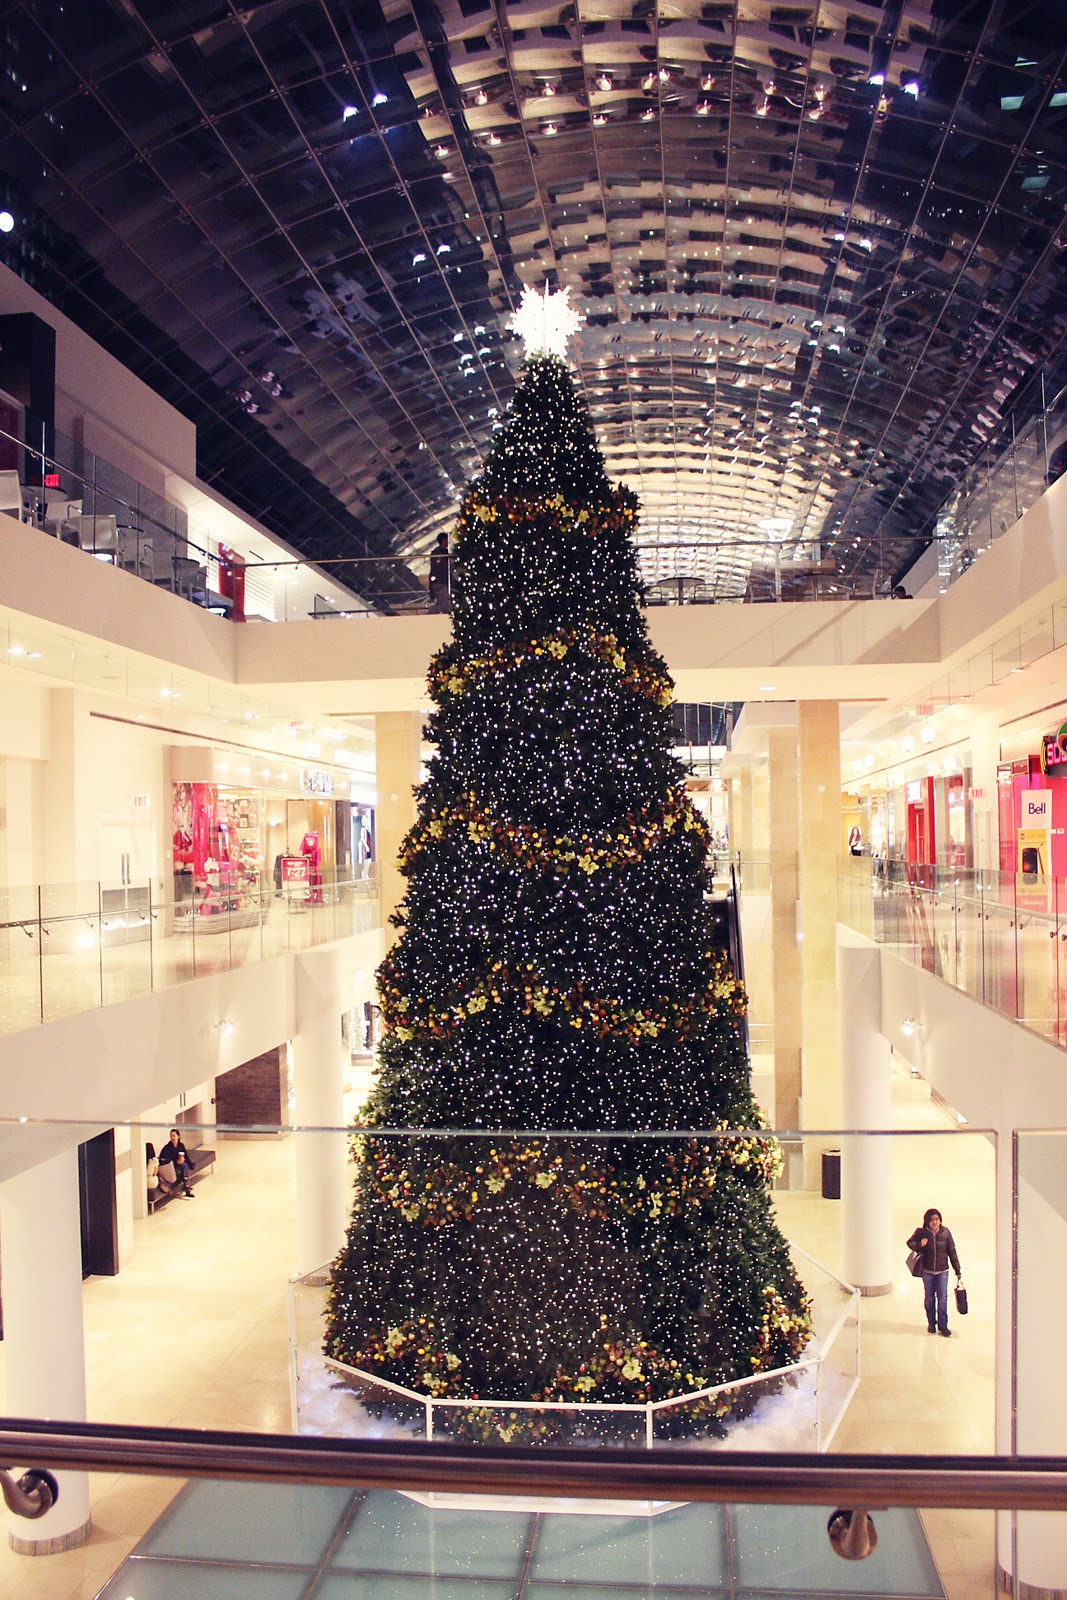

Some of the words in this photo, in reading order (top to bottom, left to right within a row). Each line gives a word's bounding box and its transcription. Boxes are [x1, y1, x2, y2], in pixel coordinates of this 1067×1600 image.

[46, 474, 59, 487] EXIT
[134, 796, 146, 806] EXIT
[1028, 802, 1046, 815] Bell
